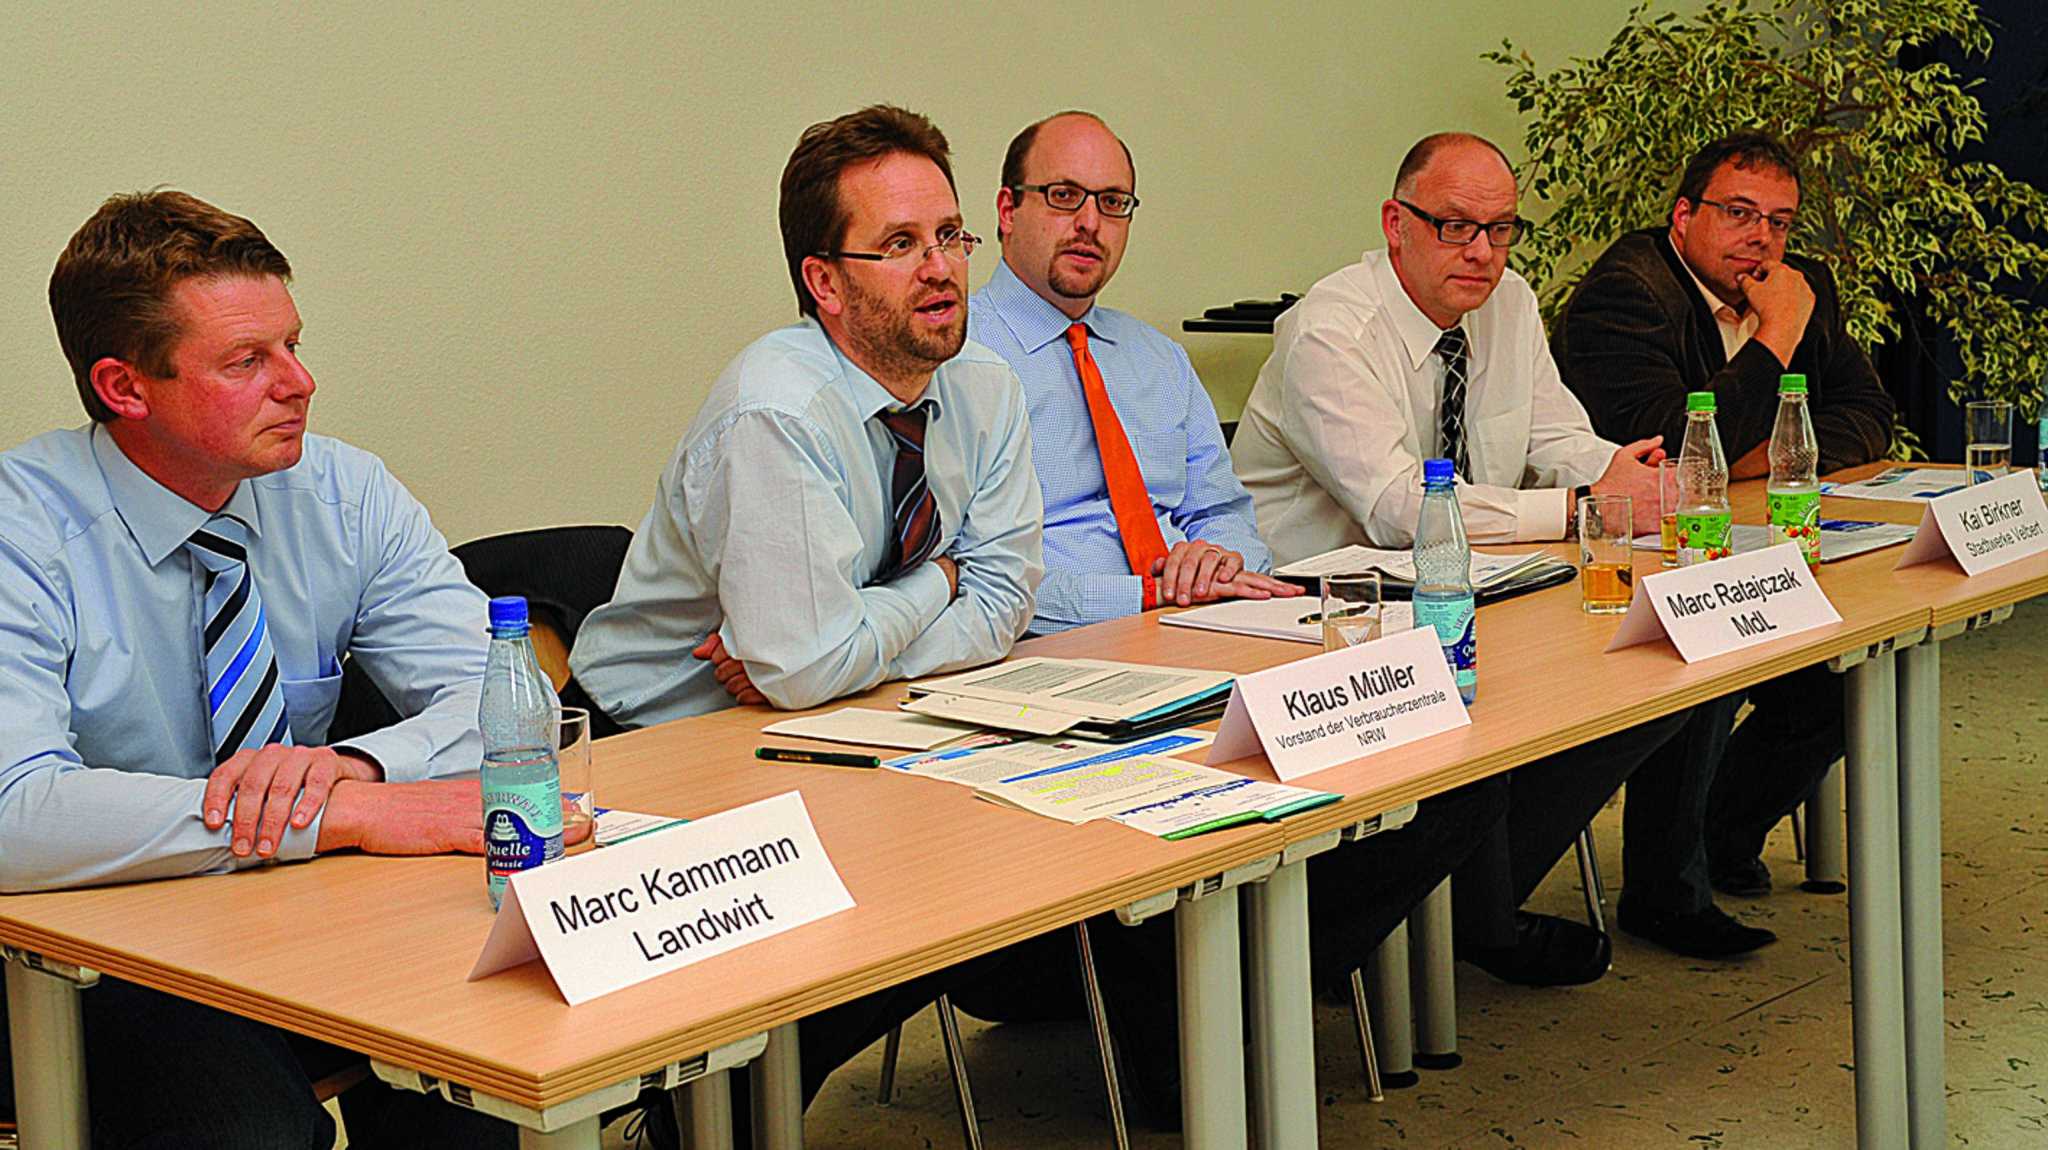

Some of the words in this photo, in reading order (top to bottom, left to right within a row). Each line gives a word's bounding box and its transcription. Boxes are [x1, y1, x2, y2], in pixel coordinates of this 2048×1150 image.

[1959, 508, 1984, 532] Kai
[1980, 499, 2024, 526] Birkner
[1965, 532, 2015, 557] Stadtwerke
[2010, 521, 2043, 541] Velbert
[1666, 585, 1716, 619] Marc
[1714, 567, 1802, 604] Ratajczak
[1731, 610, 1777, 637] MdL
[1282, 686, 1348, 721] Klaus
[1350, 664, 1416, 702] Müller
[1275, 724, 1327, 749] Vorstand
[1327, 720, 1344, 735] der
[1344, 690, 1446, 729] Verbraucherzentrale
[1357, 727, 1387, 746] NRW
[486, 842, 531, 857] Quelle
[492, 860, 523, 869] classic
[550, 887, 639, 934] Marc
[640, 837, 800, 905] Kammann
[633, 893, 774, 962] Landwirt
